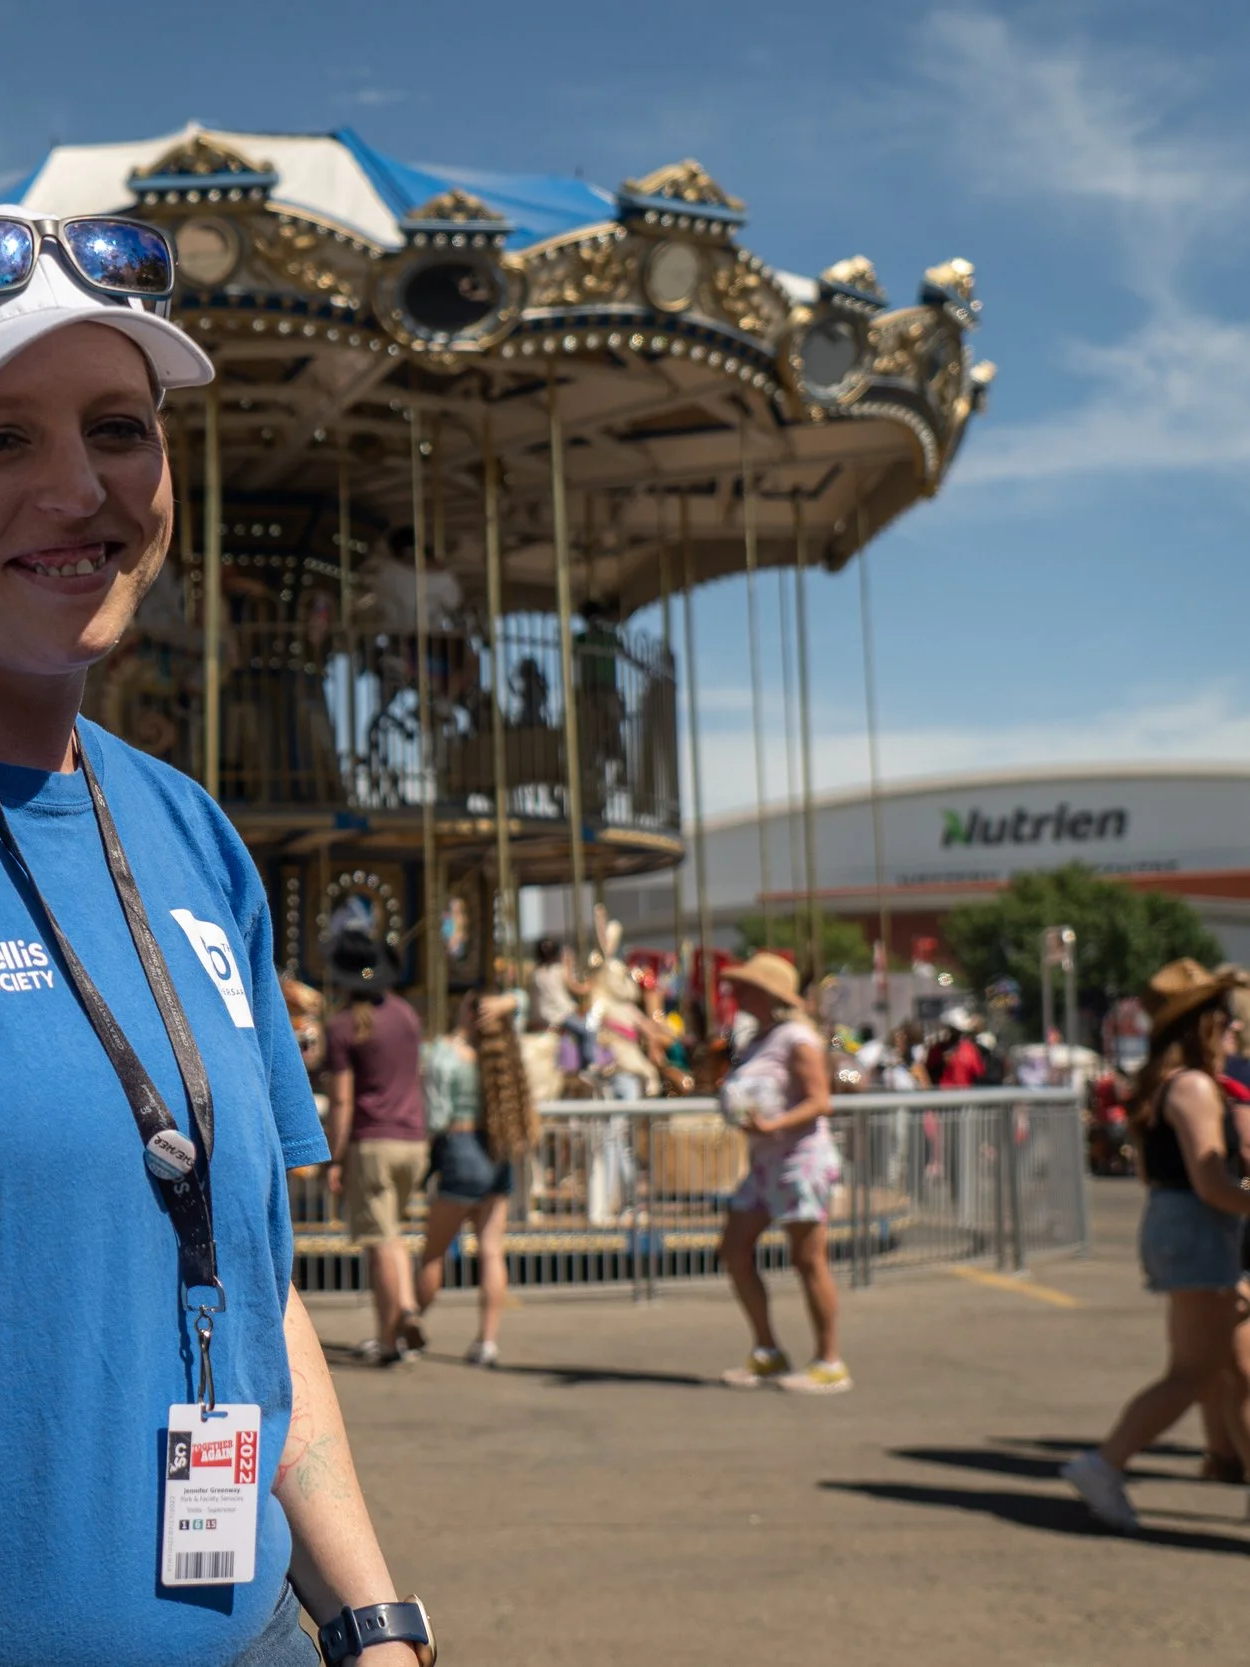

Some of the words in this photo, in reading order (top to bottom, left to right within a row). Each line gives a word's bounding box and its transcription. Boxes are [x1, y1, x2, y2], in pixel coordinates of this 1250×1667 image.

[940, 804, 1128, 848] Nutrien
[192, 1440, 232, 1453] TOGETHER
[239, 1431, 254, 1483] 2022
